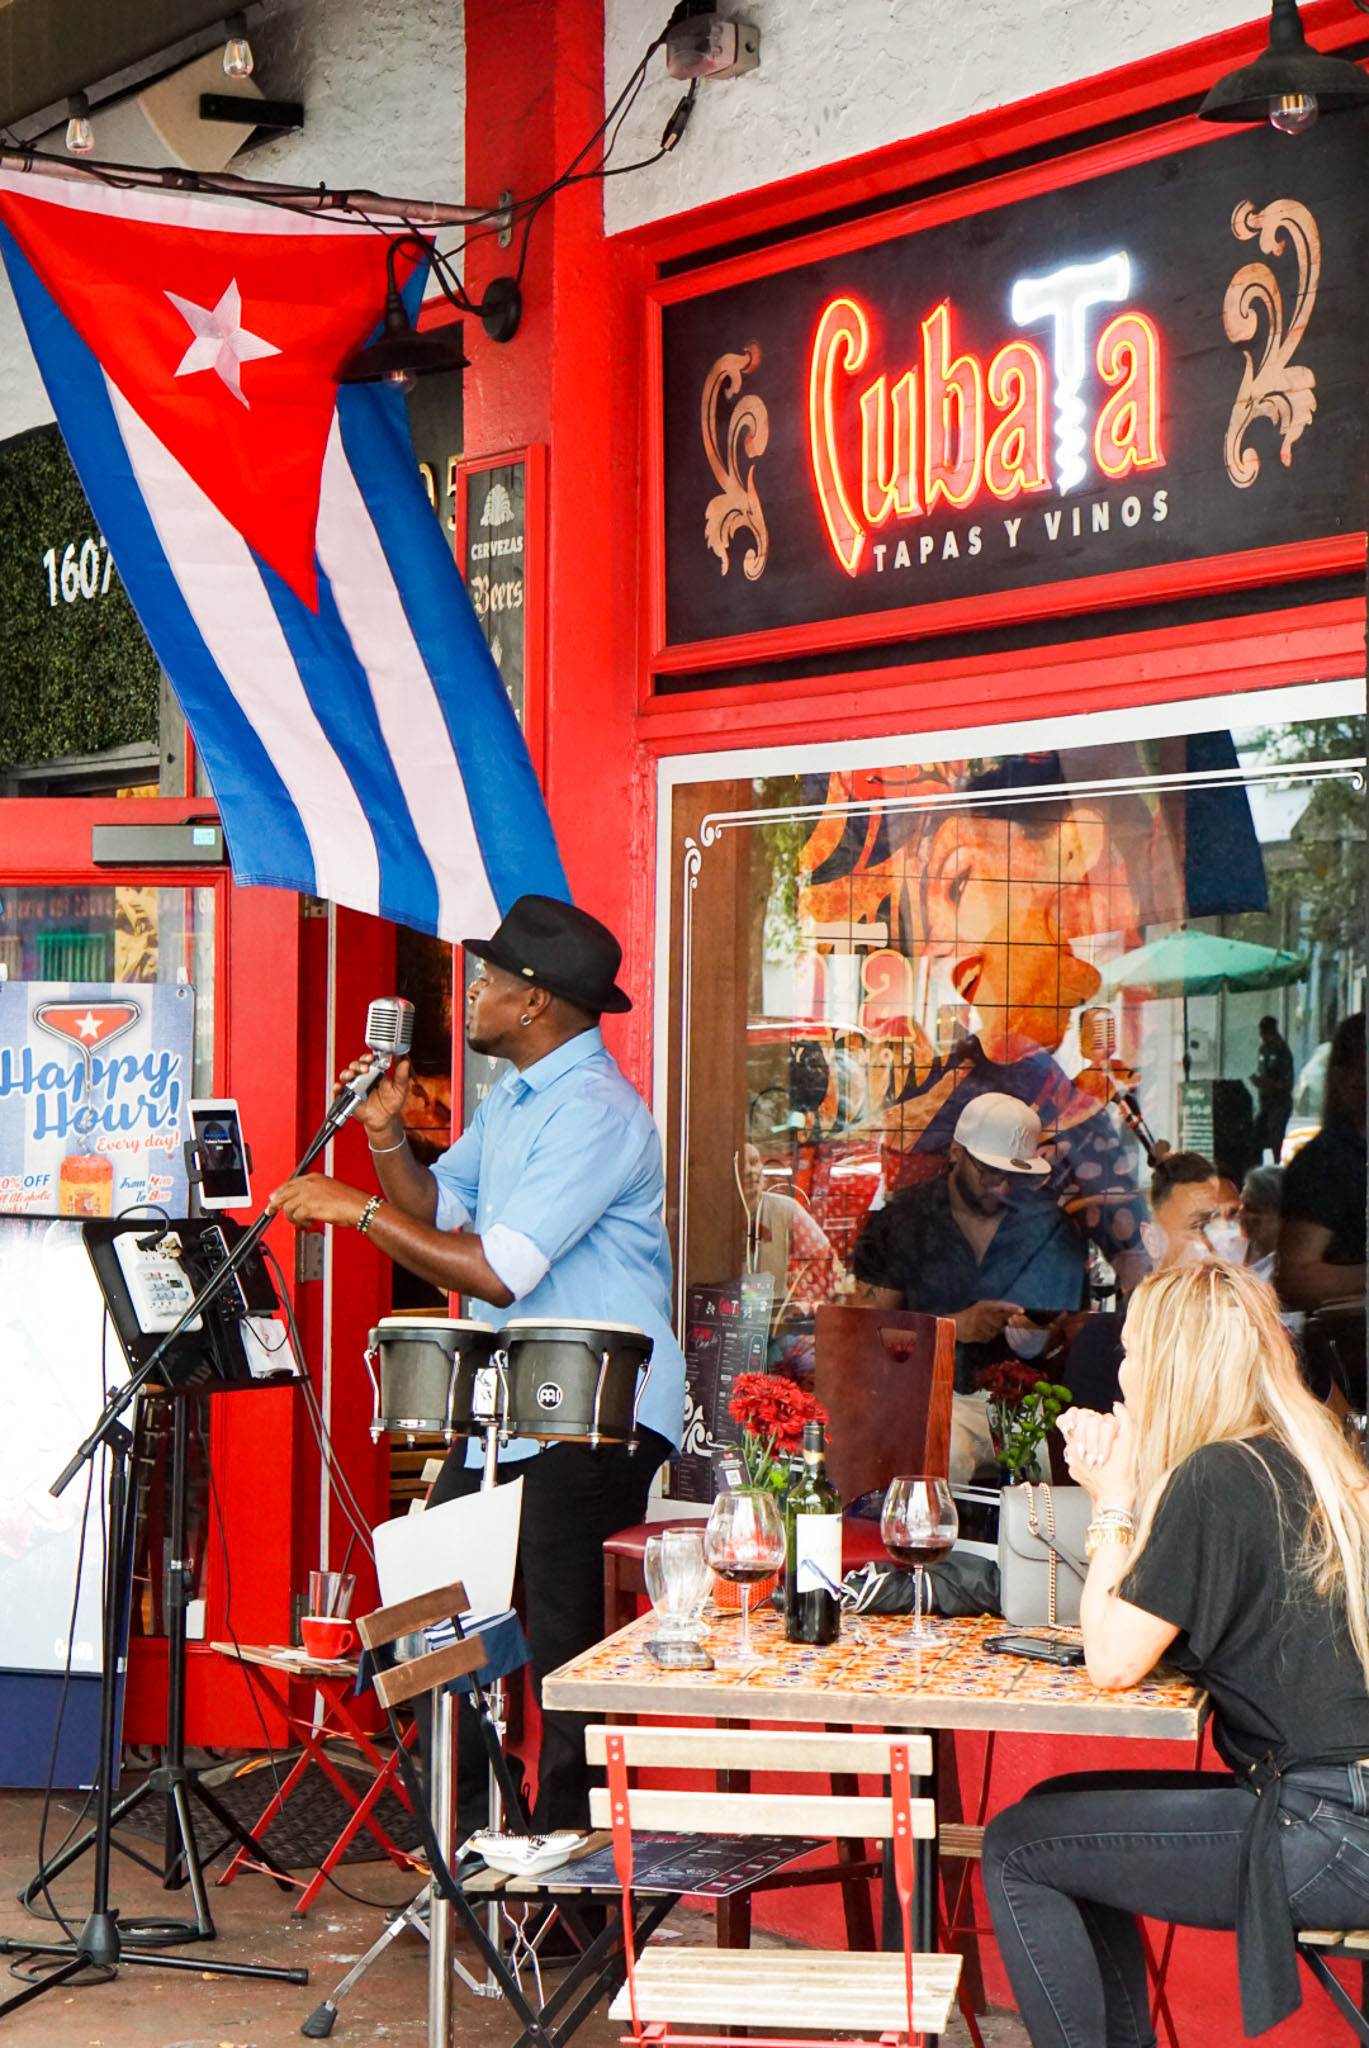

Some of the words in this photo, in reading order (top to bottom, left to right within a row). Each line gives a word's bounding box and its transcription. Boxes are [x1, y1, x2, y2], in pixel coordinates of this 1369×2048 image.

[808, 250, 1167, 578] CubaTa
[470, 535, 524, 561] CERVEZAS
[873, 525, 983, 573] TAPAS
[1004, 518, 1023, 548] Y
[1044, 489, 1169, 541] VINOS
[470, 573, 523, 620] Beers
[0, 1048, 180, 1104] Happy
[33, 1080, 180, 1140] Hour!
[97, 1137, 140, 1154] Every
[144, 1130, 179, 1151] day!
[24, 1174, 51, 1188] OFF
[120, 1176, 146, 1190] From
